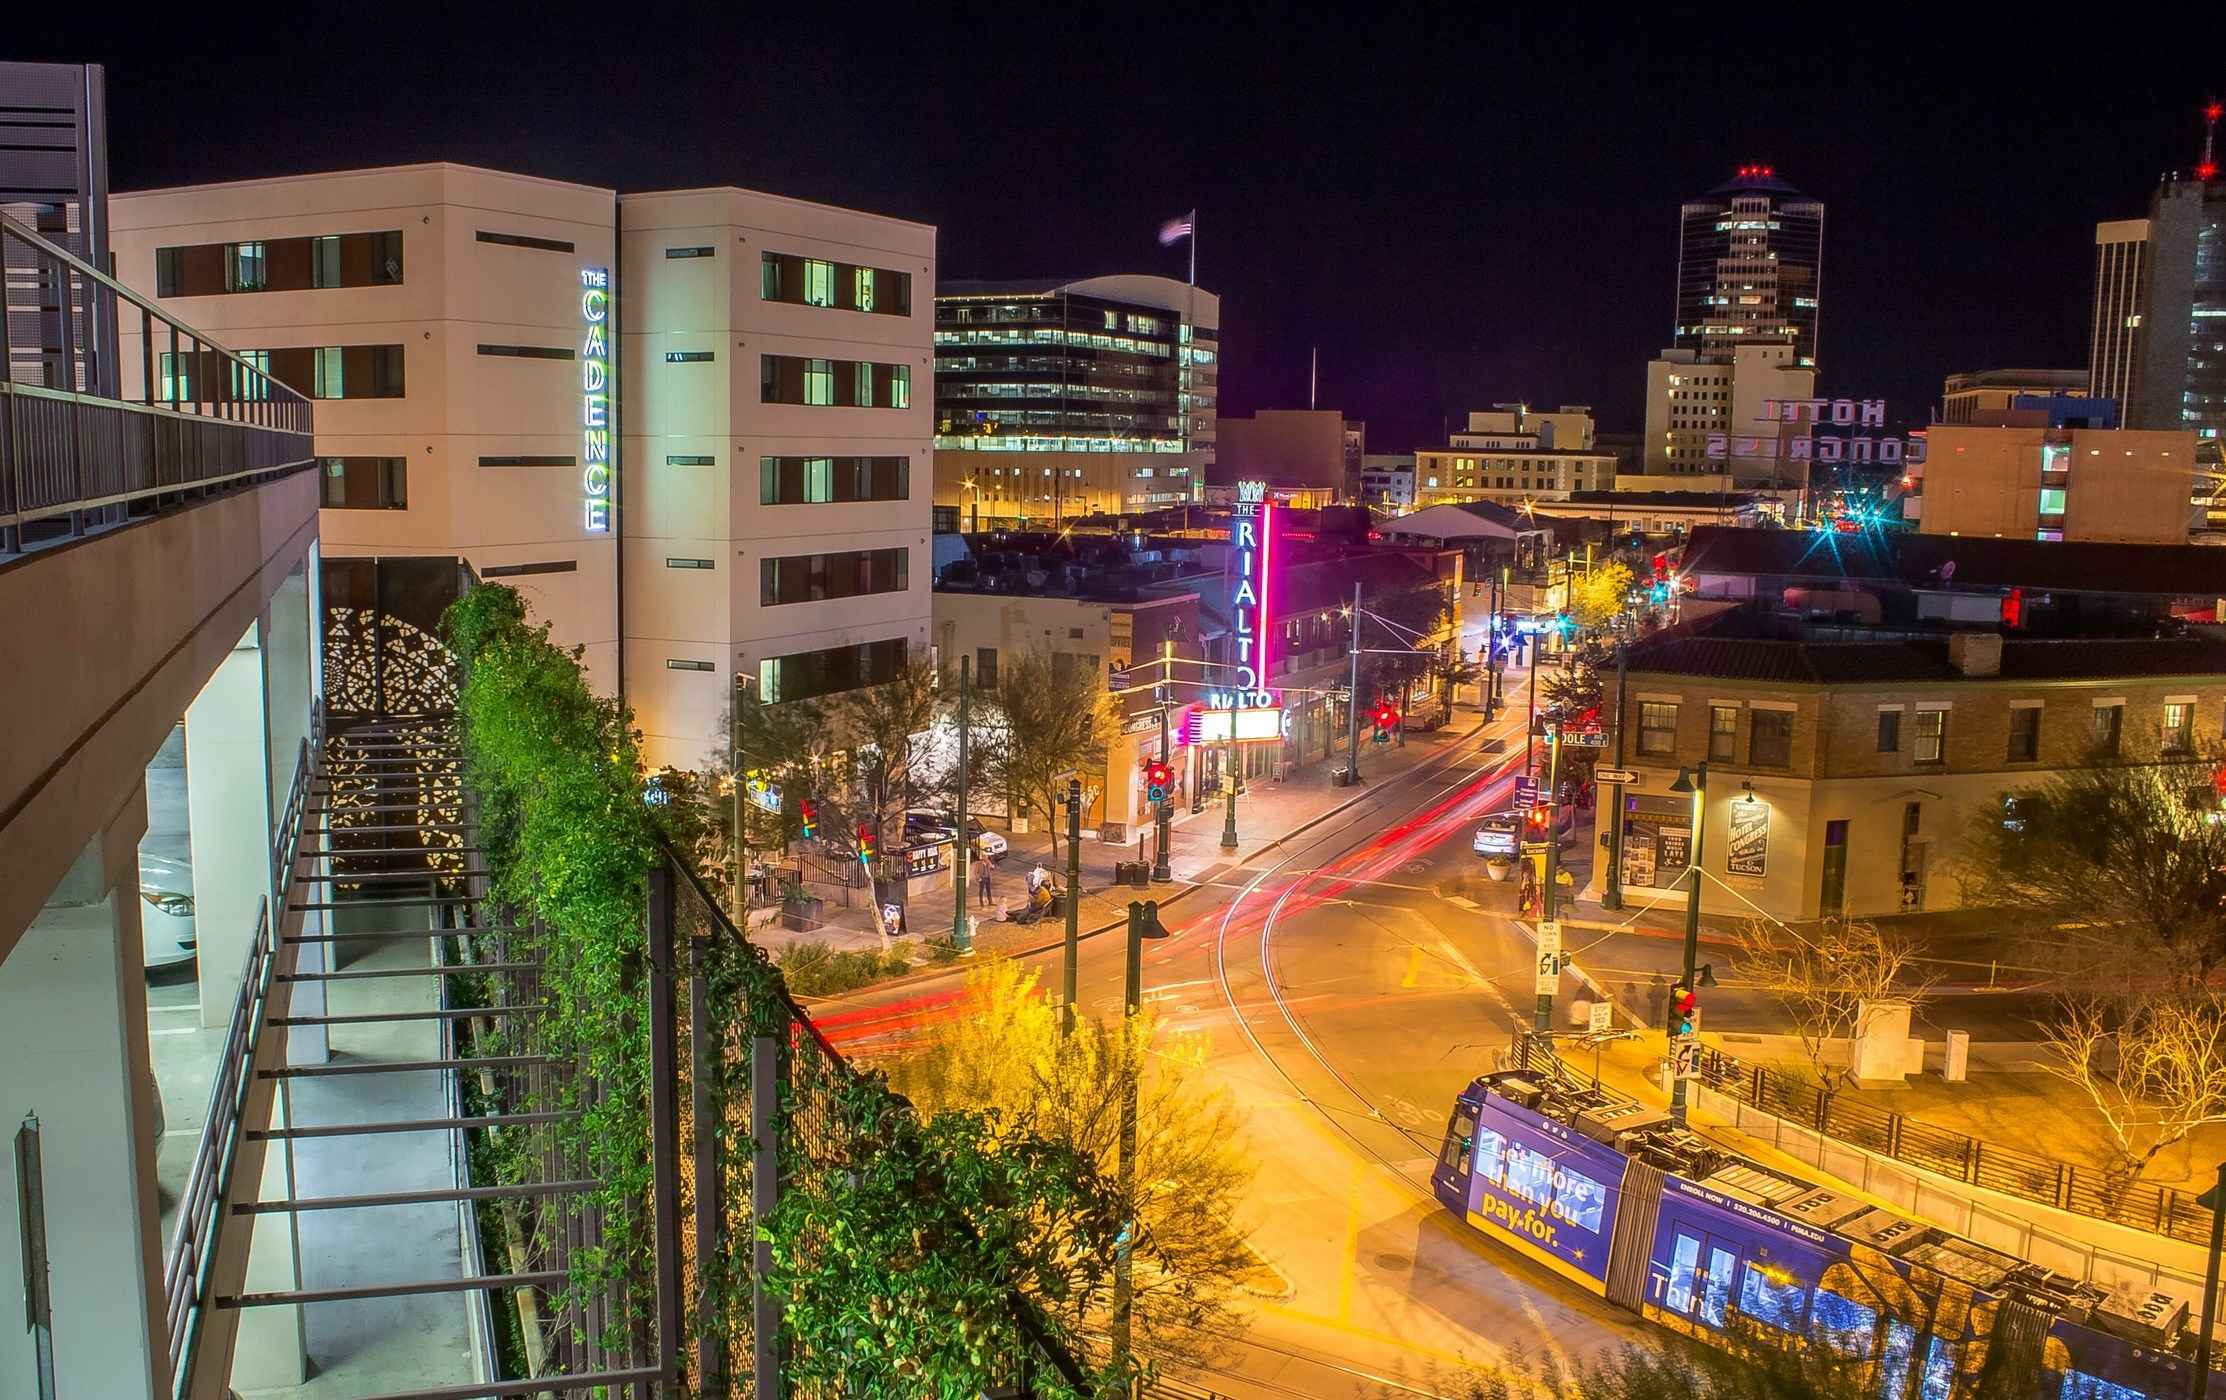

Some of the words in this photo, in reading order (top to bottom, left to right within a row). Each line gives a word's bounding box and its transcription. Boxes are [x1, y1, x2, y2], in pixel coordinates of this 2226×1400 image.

[581, 270, 607, 287] THE
[582, 289, 607, 529] CADENCE
[1236, 504, 1255, 515] THE
[1234, 522, 1257, 691] RIALTO
[1730, 863, 1762, 873] TUCSON
[1481, 1191, 1520, 1230] pay
[1519, 1207, 1559, 1248] for.
[1488, 1162, 1534, 1205] than
[1540, 1193, 1578, 1227] you
[1680, 1183, 1705, 1198] ENROLL
[1705, 1192, 1724, 1205] NOW
[1733, 1203, 1780, 1226] 520.206.4500
[1790, 1224, 1825, 1243] PIMA.EDU
